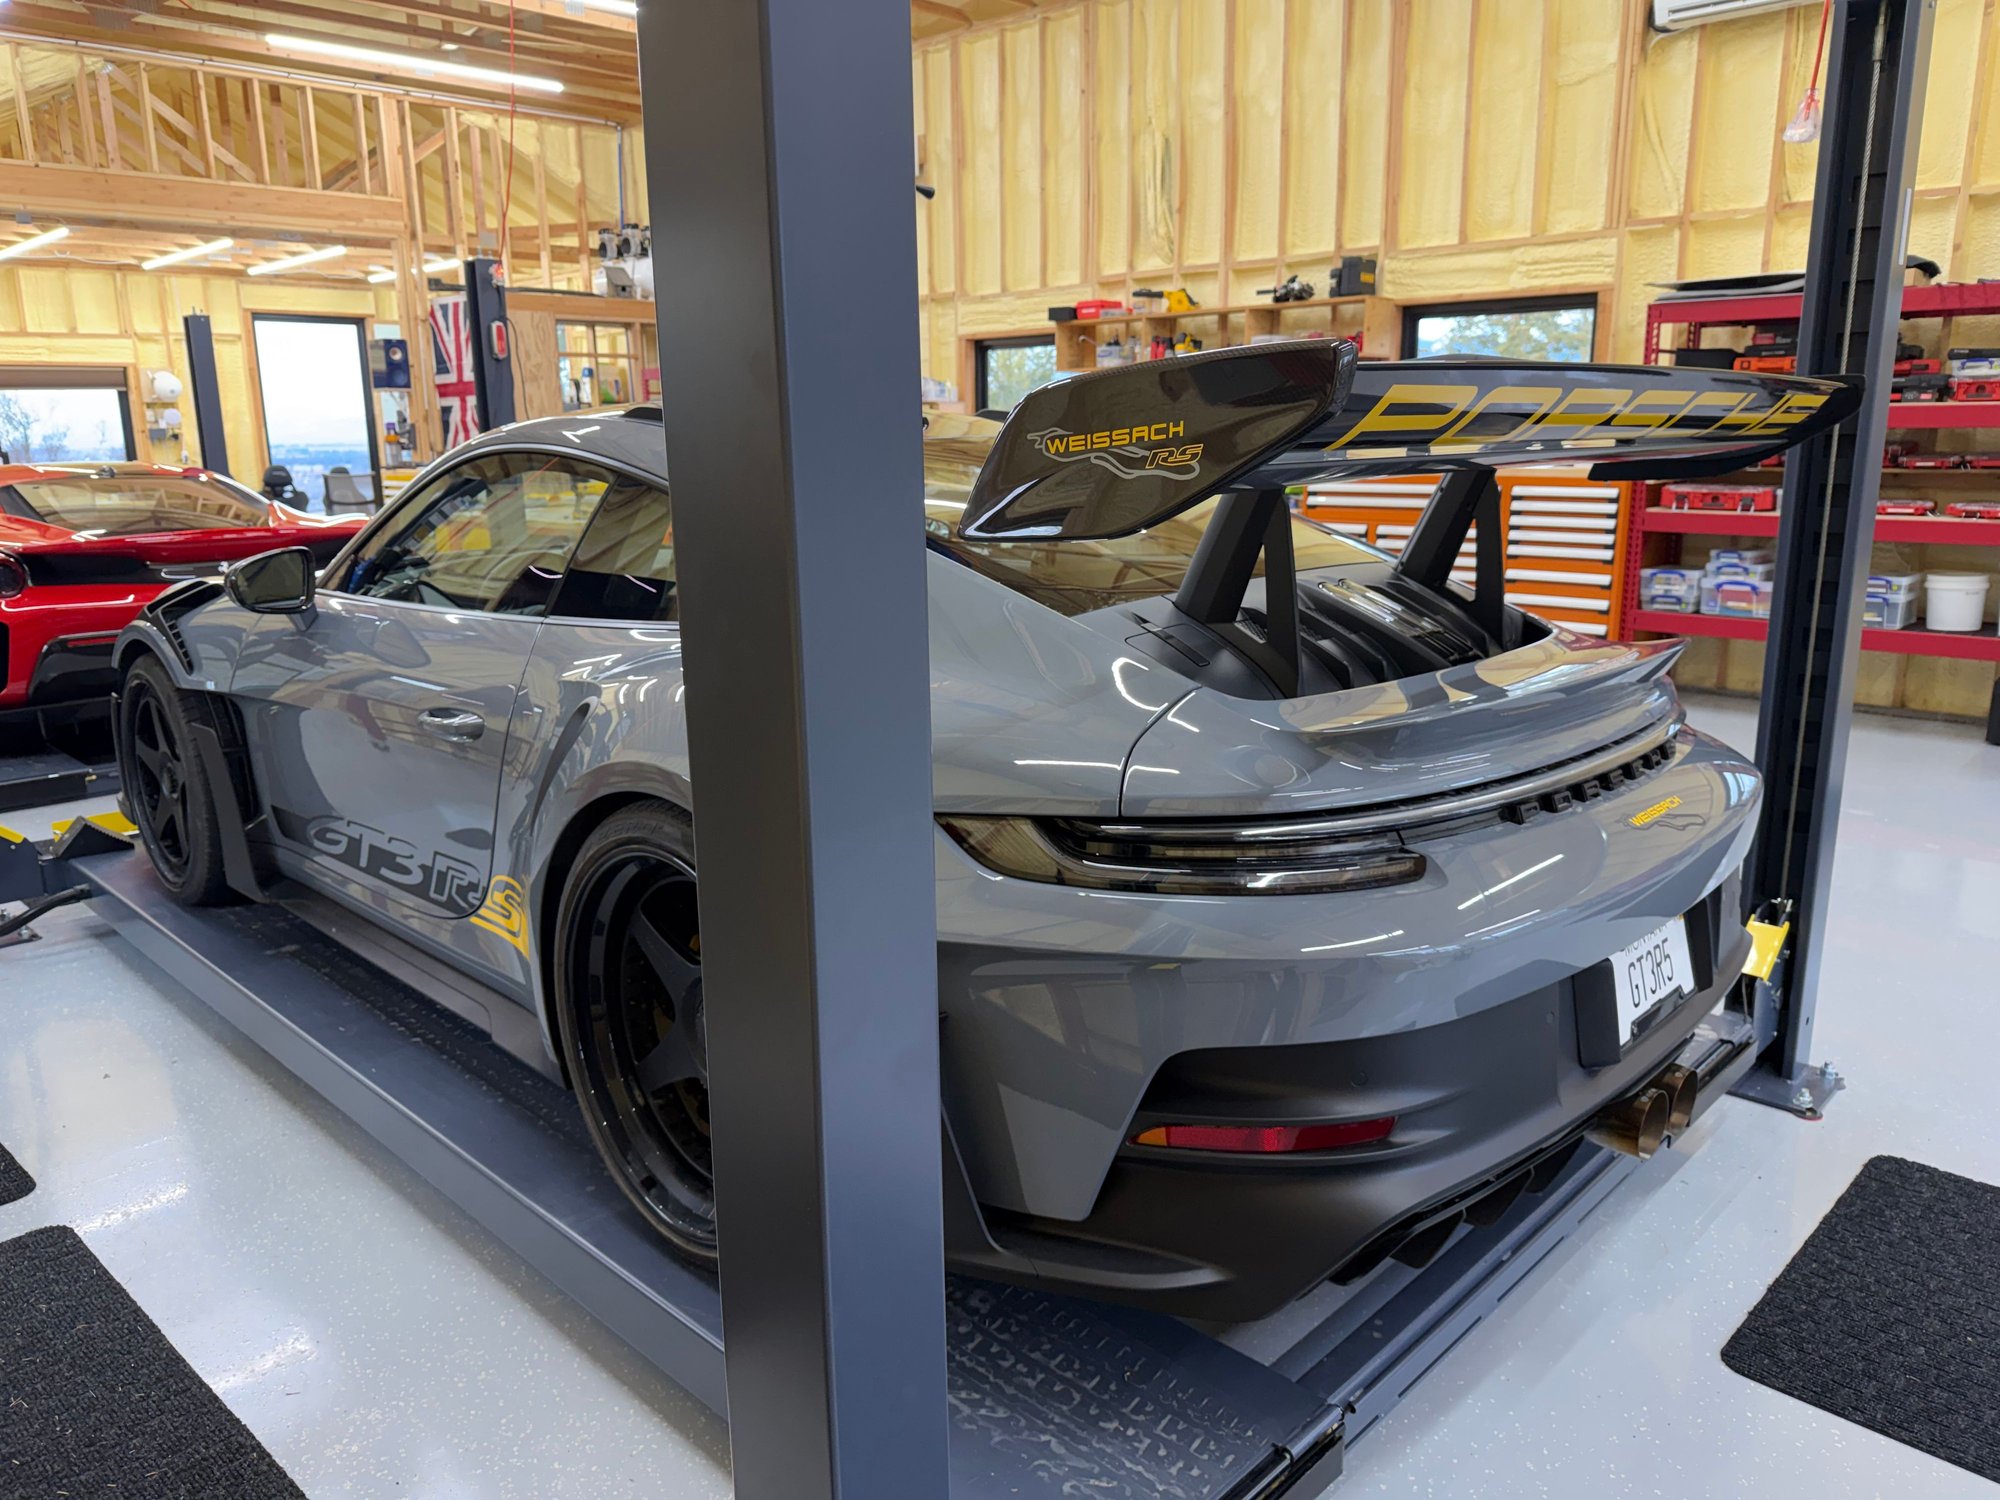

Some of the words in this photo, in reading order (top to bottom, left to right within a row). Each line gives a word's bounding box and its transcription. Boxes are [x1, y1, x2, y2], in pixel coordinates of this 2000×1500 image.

[1046, 420, 1184, 454] WEISSACH
[1324, 384, 1830, 451] PORSCHE
[1145, 444, 1204, 469] RS
[1628, 795, 1682, 827] WEISSACH
[306, 815, 530, 942] GT3RS
[1628, 938, 1675, 1008] GT3R5
